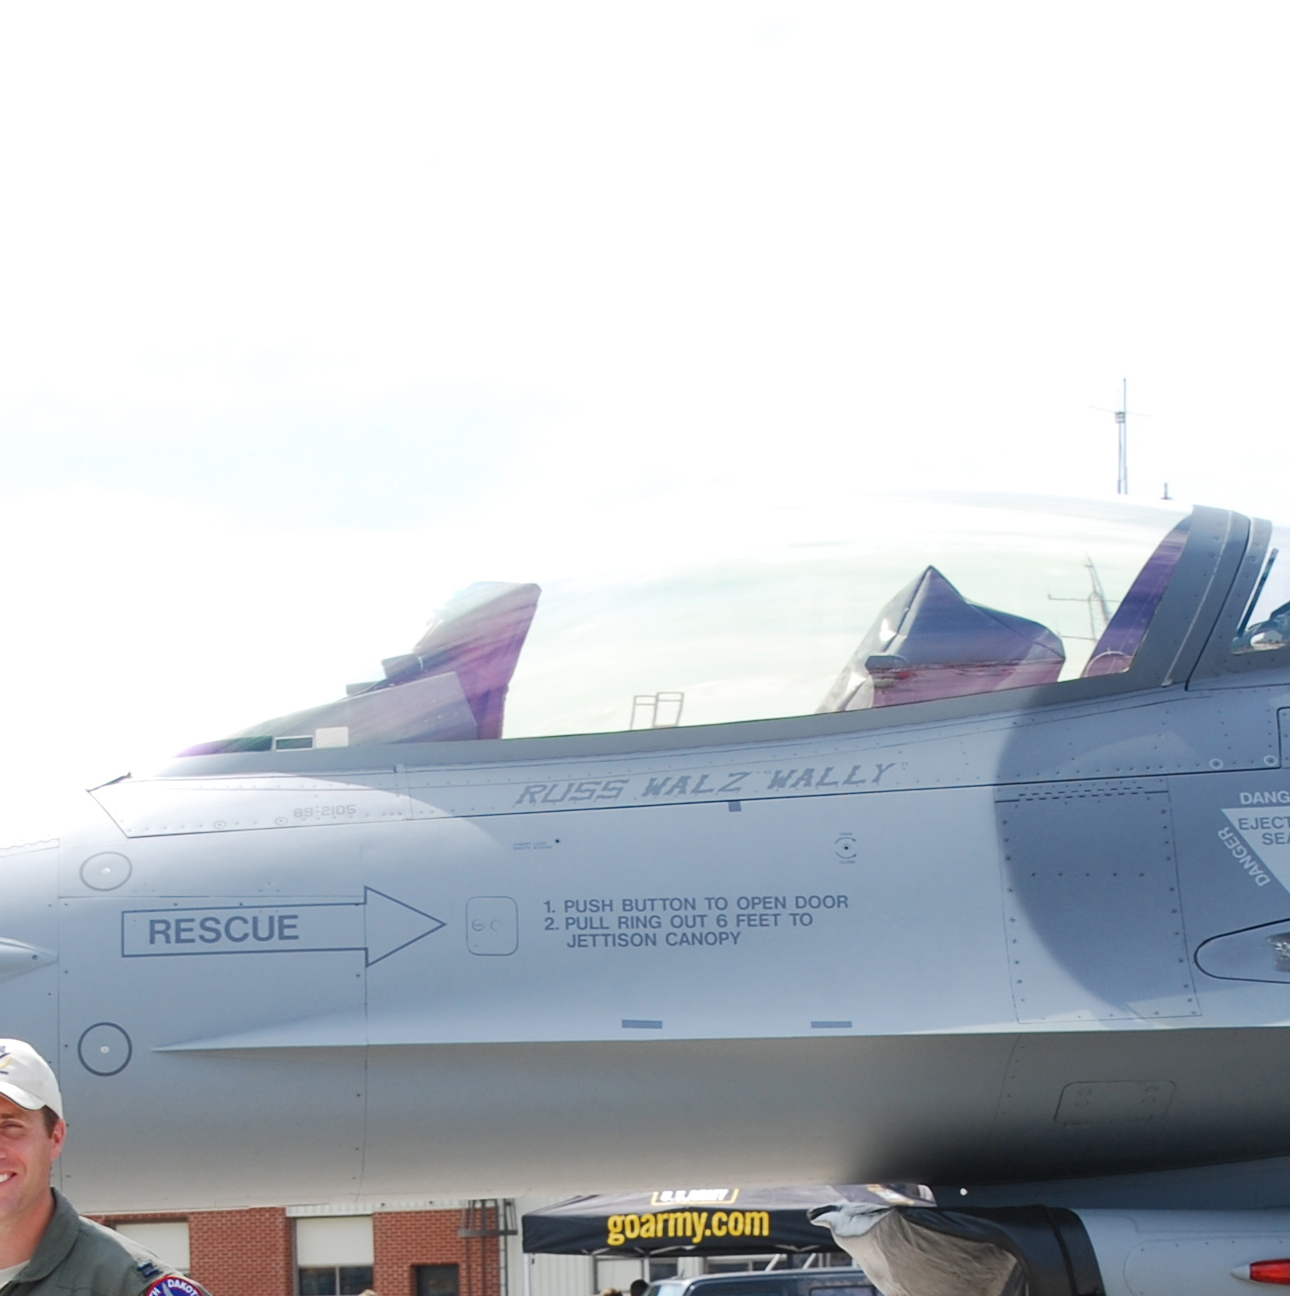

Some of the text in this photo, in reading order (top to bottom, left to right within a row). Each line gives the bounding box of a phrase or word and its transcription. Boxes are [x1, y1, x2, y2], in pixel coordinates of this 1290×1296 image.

[514, 779, 630, 804] RUSS
[641, 771, 752, 798] WALZ
[1217, 826, 1271, 887] DANGER
[543, 895, 849, 914] 1. PUSH BUTTON TO OPEN DOOR
[149, 914, 299, 945] RESCUE
[544, 912, 814, 931] 2. PULL RING OUT 6 FEET TO
[566, 931, 742, 948] JETTISON CANOPY
[607, 1210, 770, 1246] goarmy.com
